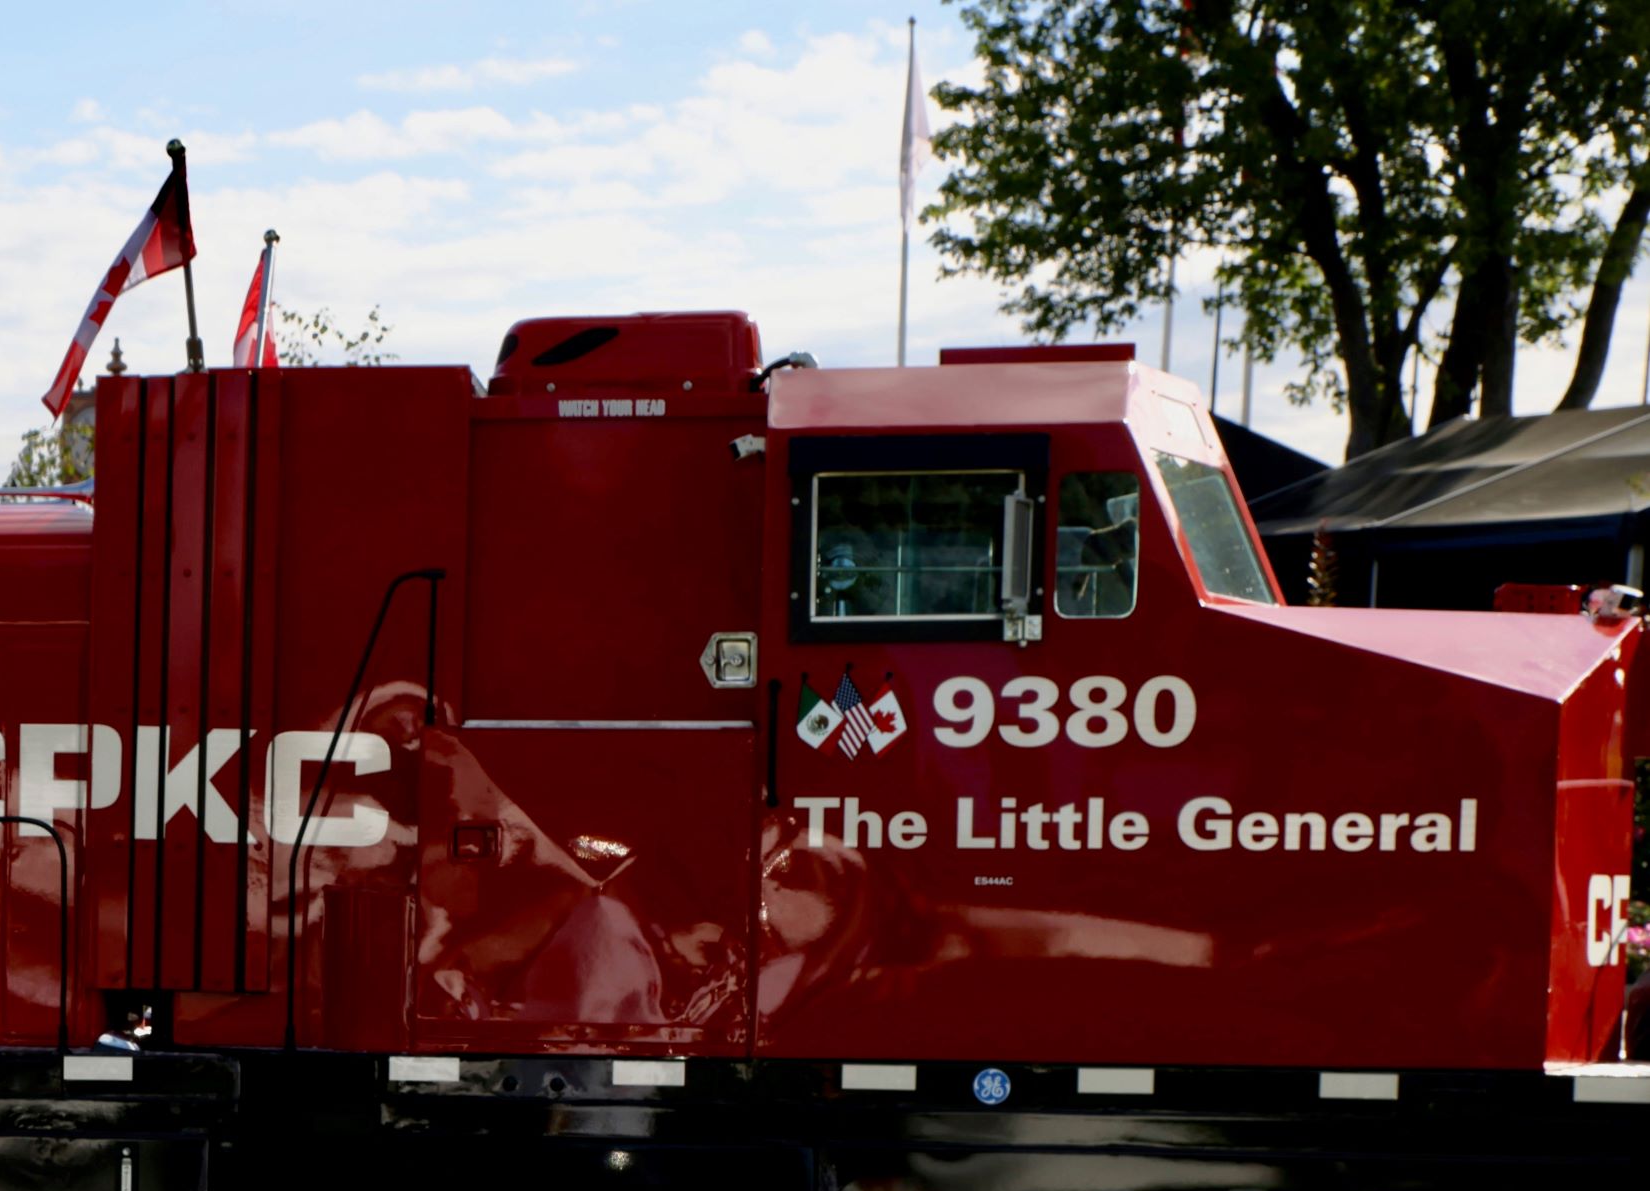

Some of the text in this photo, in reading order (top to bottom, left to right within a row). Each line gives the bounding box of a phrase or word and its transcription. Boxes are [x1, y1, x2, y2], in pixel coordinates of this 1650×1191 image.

[558, 399, 666, 417] WATCH YOUR HEAD
[932, 675, 1197, 748] 9380
[793, 796, 1478, 852] The Little General
